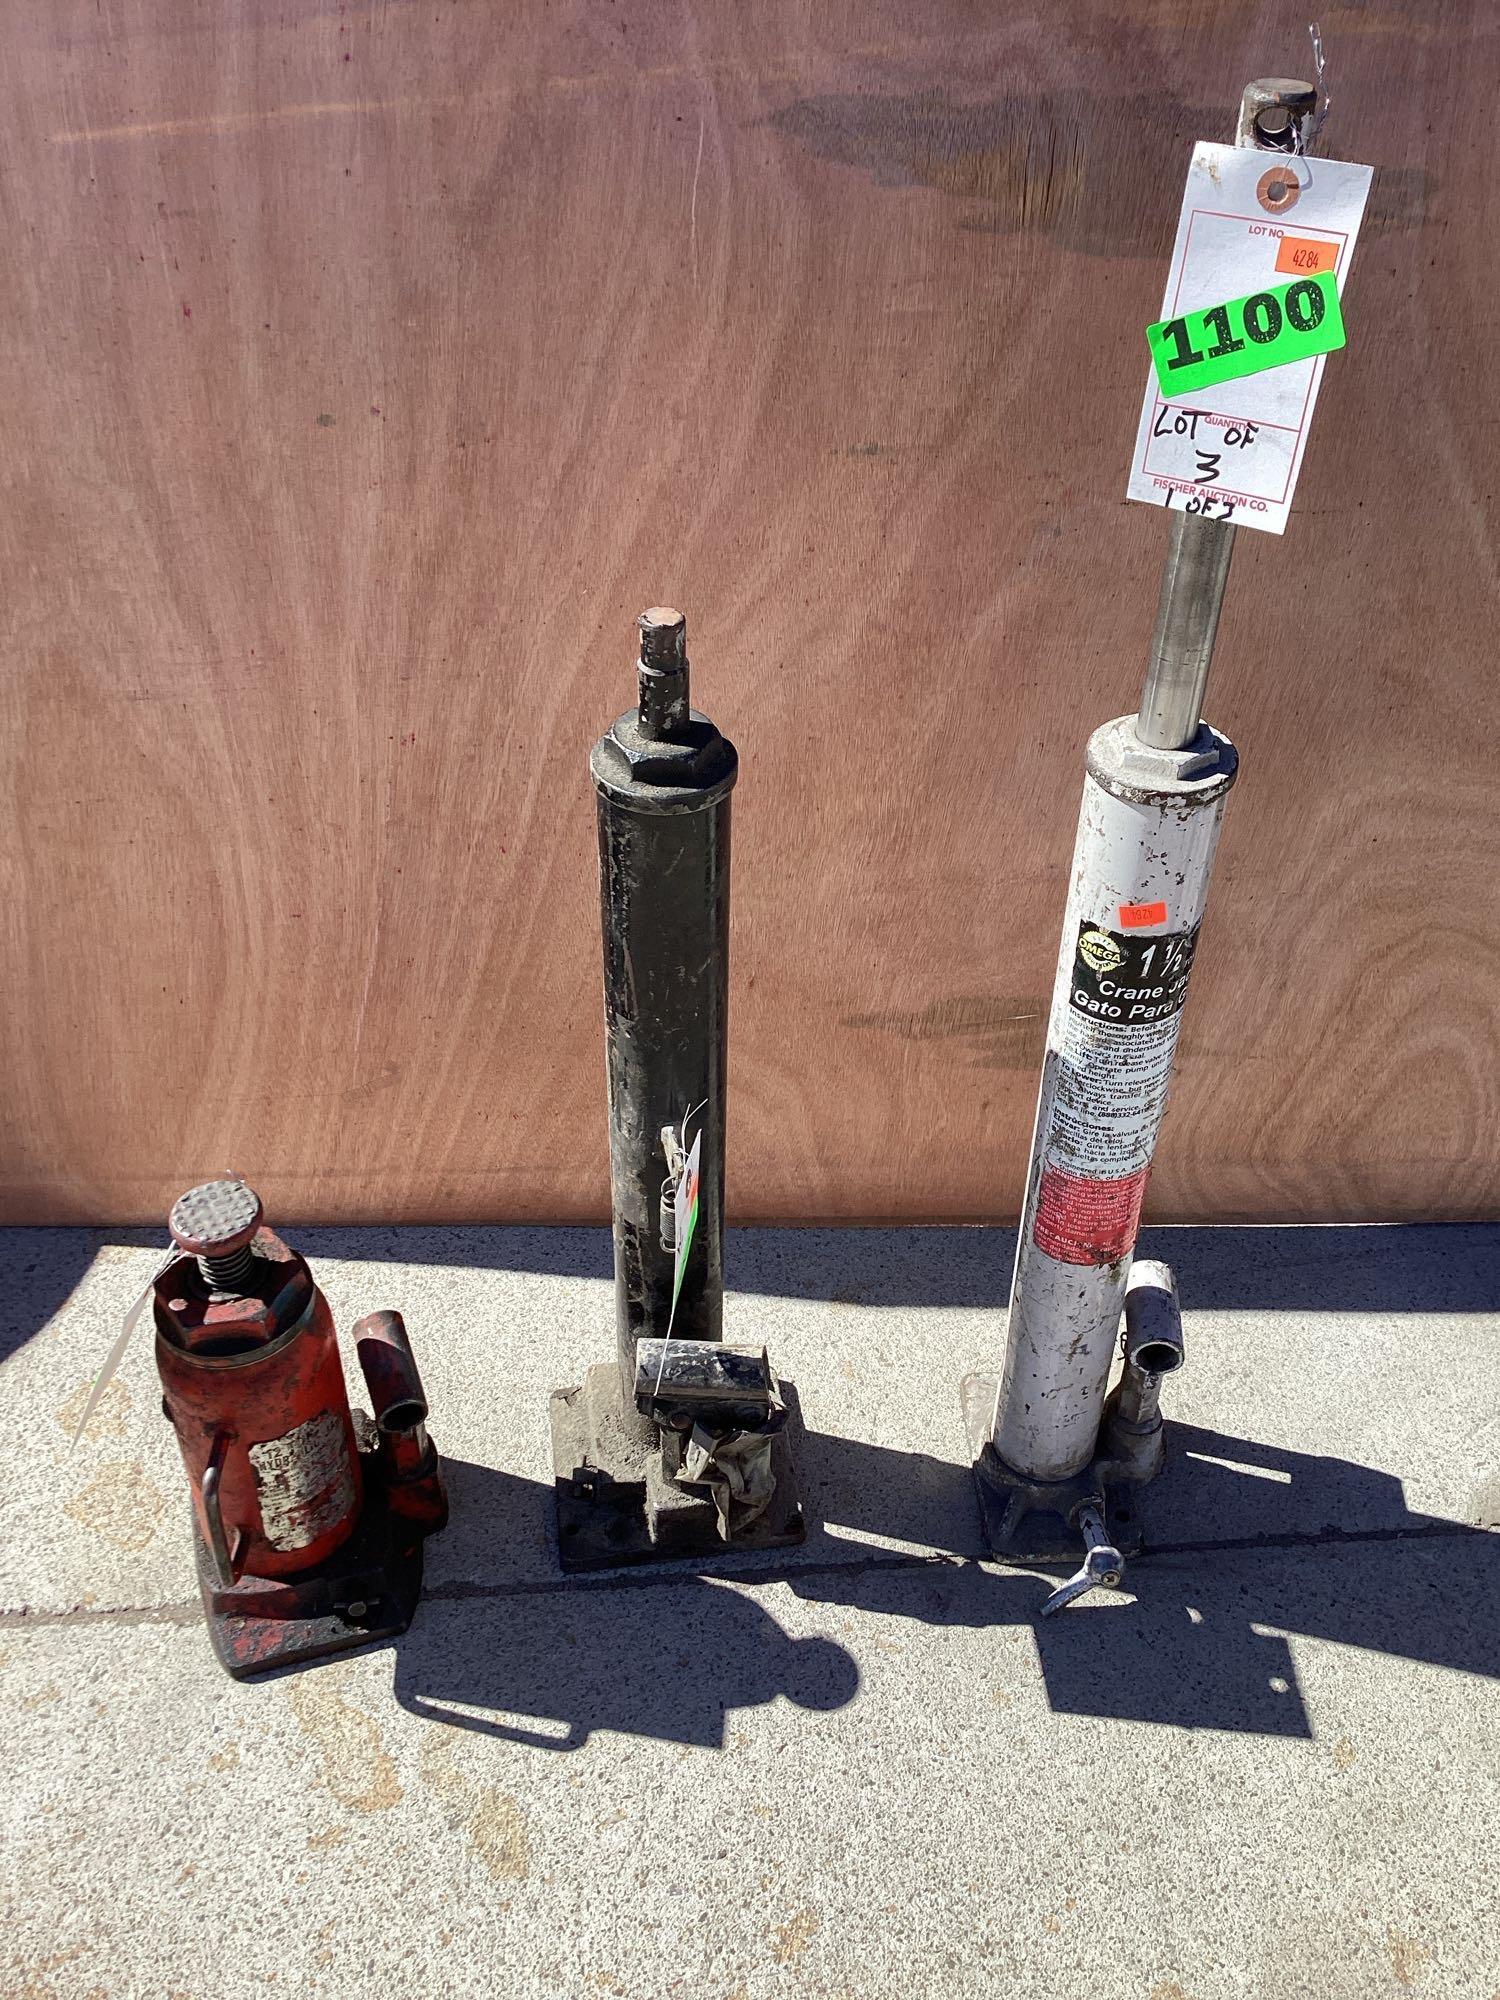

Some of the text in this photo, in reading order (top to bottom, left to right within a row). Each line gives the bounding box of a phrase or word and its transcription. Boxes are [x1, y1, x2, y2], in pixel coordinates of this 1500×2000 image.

[1248, 224, 1268, 236] LOT
[1292, 249, 1319, 268] 4284
[1162, 279, 1326, 371] 1100
[1153, 405, 1259, 449] LOT OF
[1204, 415, 1250, 430] QUANTITY
[1194, 449, 1221, 484] 3
[1152, 478, 1269, 513] FISCHER AUCTION CO.
[1185, 496, 1218, 515] OF
[1078, 937, 1121, 963] OMEGA
[1099, 980, 1164, 1000] Crane
[1074, 989, 1174, 1018] Gato Para
[1061, 1060, 1071, 1071] To
[1104, 1078, 1124, 1087] Turn
[1125, 1065, 1149, 1075] pump
[1082, 1128, 1100, 1137] Gire
[1086, 1142, 1104, 1150] Gire
